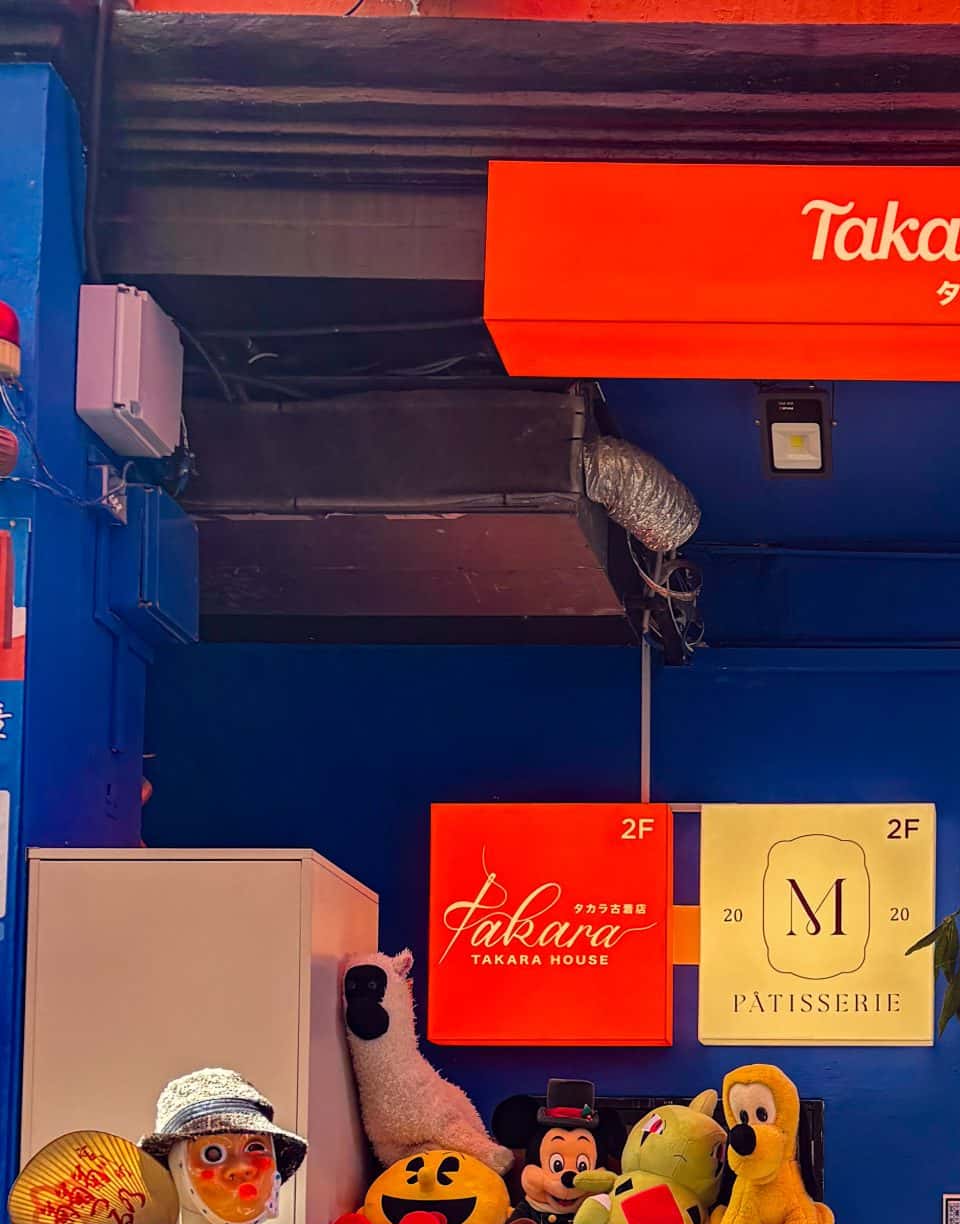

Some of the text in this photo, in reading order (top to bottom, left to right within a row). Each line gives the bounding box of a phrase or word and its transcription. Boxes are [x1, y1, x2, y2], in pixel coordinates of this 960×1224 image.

[621, 818, 655, 840] 2F
[887, 819, 920, 840] 2F
[439, 872, 657, 964] Takara
[574, 904, 647, 915] タカラ古着店
[723, 878, 910, 936] 20 M 20
[471, 955, 609, 965] TAKARA HOUSE
[733, 990, 902, 1013] PÂTISSERIE
